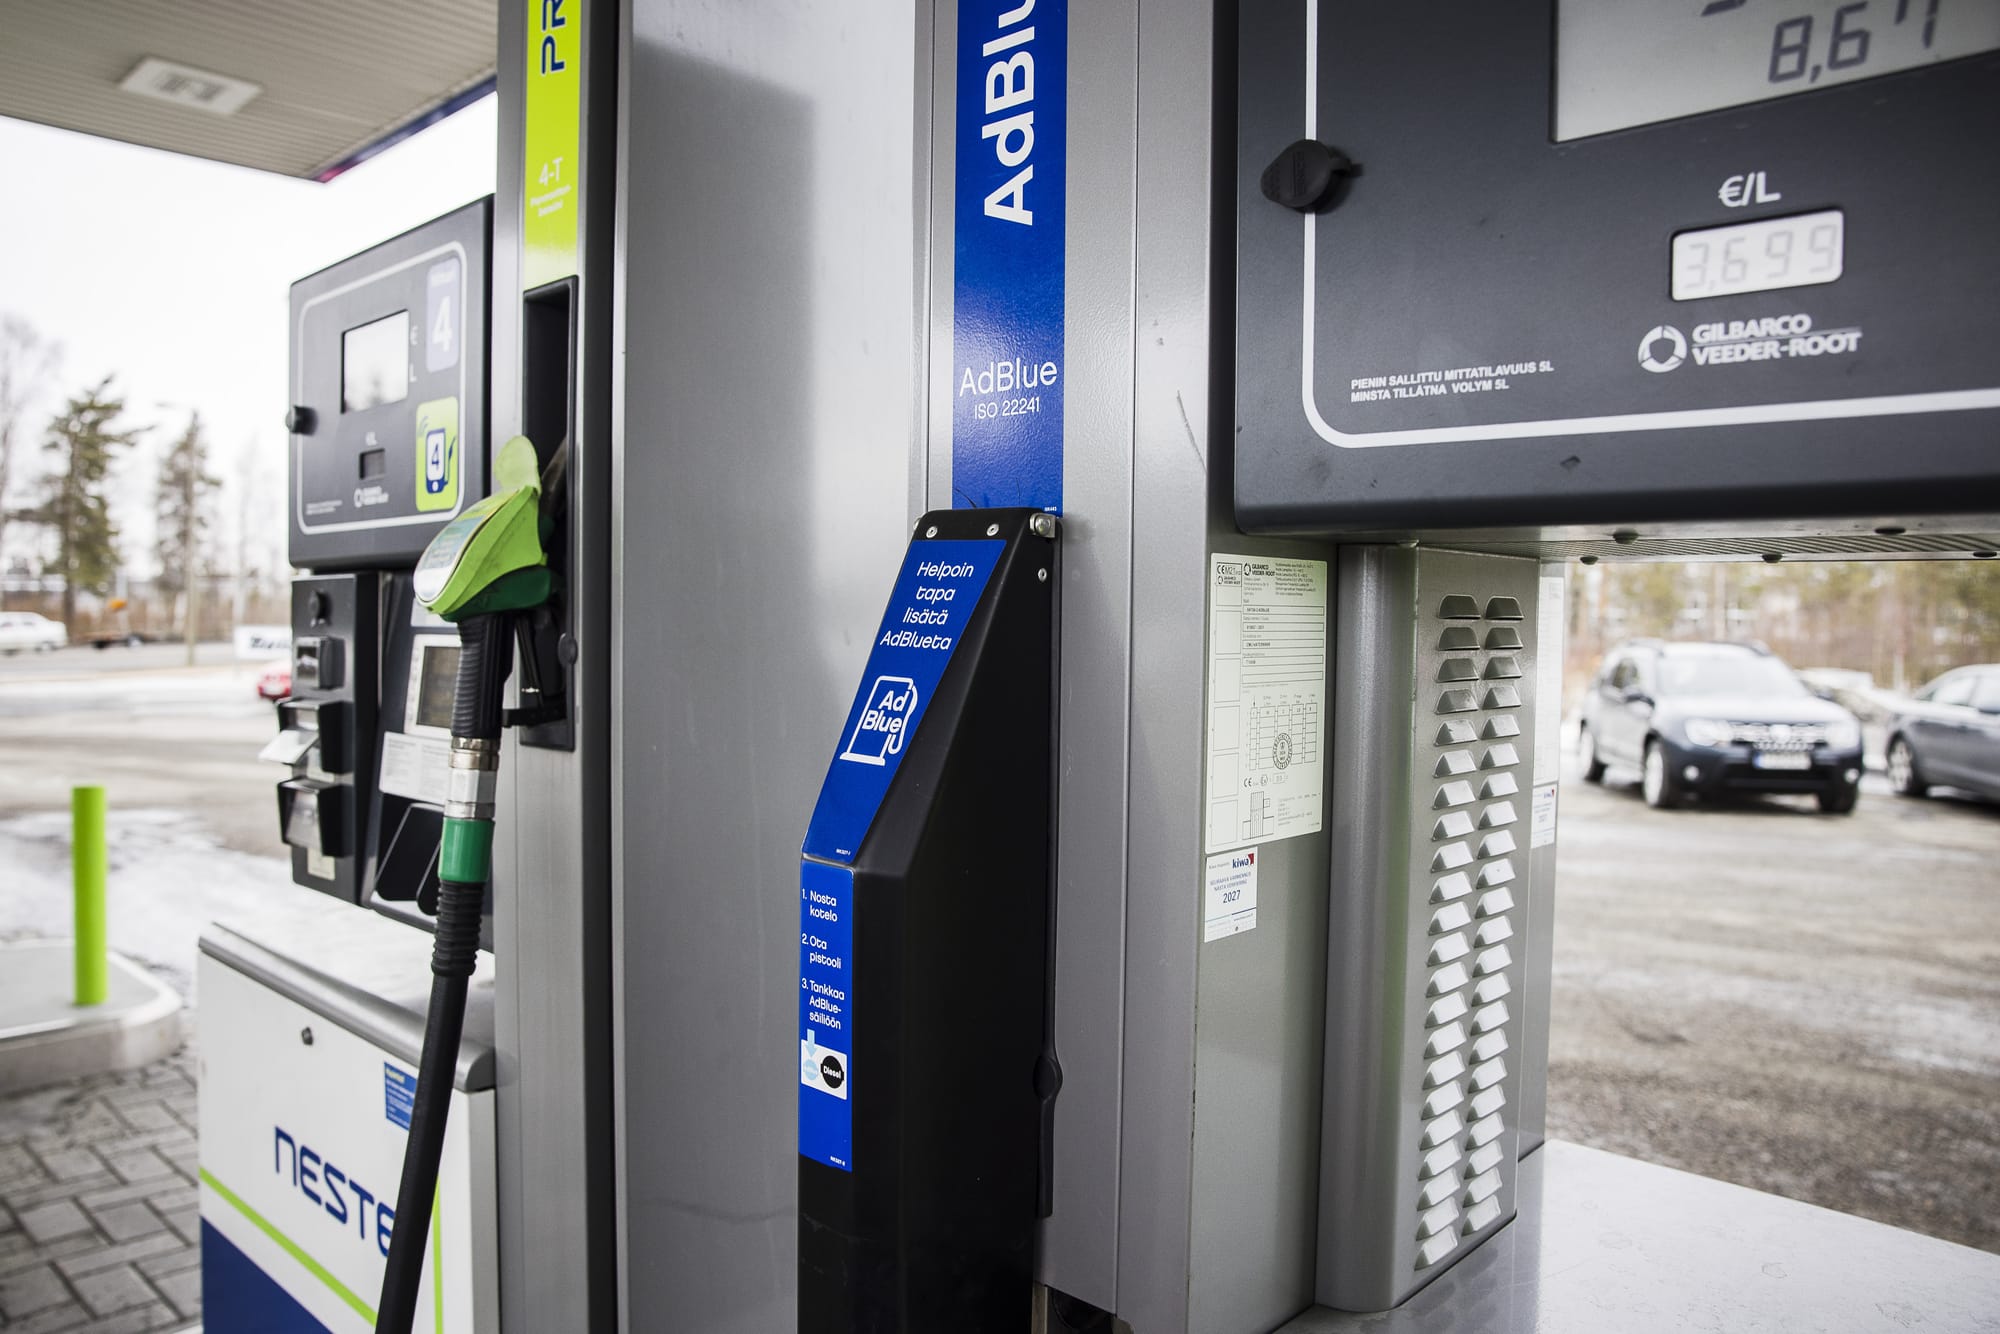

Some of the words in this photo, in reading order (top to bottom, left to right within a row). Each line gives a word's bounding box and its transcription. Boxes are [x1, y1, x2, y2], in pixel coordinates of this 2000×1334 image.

[1718, 171, 1781, 208] €/L
[432, 296, 453, 352] 4
[1692, 313, 1812, 344] GILBARCO
[1692, 331, 1862, 366] VEEDER-ROOT
[959, 357, 1057, 397] AdBlue
[1351, 376, 1387, 390] PIENIN
[1389, 371, 1445, 386] SALLITTU
[1445, 362, 1536, 380] MITTATILAVUUS
[1539, 360, 1554, 372] 5L
[1351, 388, 1391, 402] MINSTA
[1451, 380, 1493, 394] VOLYM
[1495, 378, 1509, 390] 5L
[974, 402, 998, 420] ISO
[1002, 396, 1041, 417] 22241
[431, 443, 440, 471] 4
[917, 561, 974, 581] Helpoin
[916, 585, 955, 605] tapa
[902, 606, 948, 625] lisätä
[880, 630, 952, 650] AdBlueta
[878, 690, 909, 712] Ad
[863, 710, 902, 732] Blue
[1232, 858, 1250, 869] kiwa
[802, 888, 808, 900] 1.
[810, 890, 837, 907] Nosta
[1223, 889, 1241, 904] 2027
[810, 905, 838, 922] kotelo
[802, 933, 809, 945] 2.
[810, 935, 827, 950] Ota
[810, 951, 842, 969] pistooli
[802, 978, 809, 990] 3.
[810, 979, 845, 1001] Tankkaa
[809, 995, 842, 1013] AdBlue-
[809, 1011, 842, 1030] säiliöön
[823, 1064, 842, 1080] Diesel
[275, 1126, 396, 1258] NESTE
